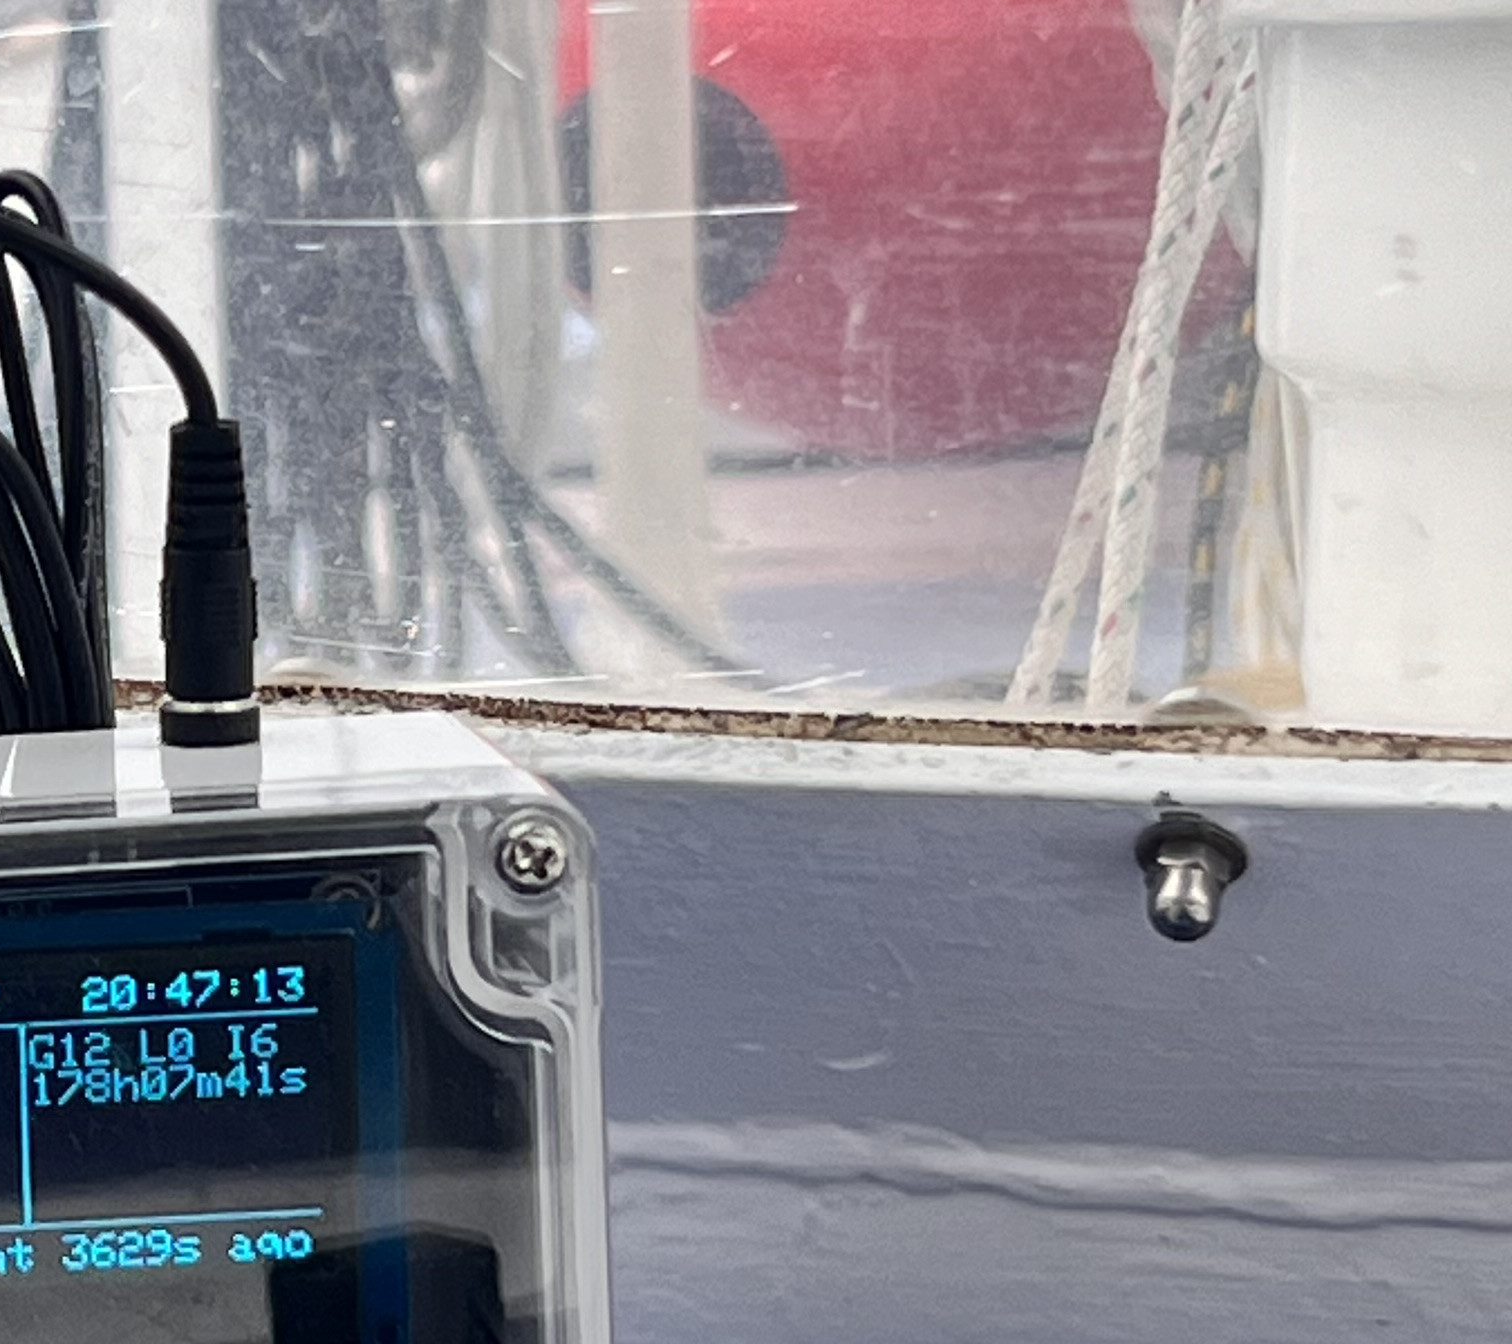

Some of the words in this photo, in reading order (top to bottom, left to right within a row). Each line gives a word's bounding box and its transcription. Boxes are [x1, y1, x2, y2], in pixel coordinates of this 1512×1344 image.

[81, 965, 305, 1013] 20:47:13
[29, 1032, 111, 1070] G12
[140, 1027, 194, 1064] L0
[228, 1023, 278, 1060] I6
[33, 1060, 308, 1106] 178h07m41s
[61, 1229, 202, 1272] 3629s
